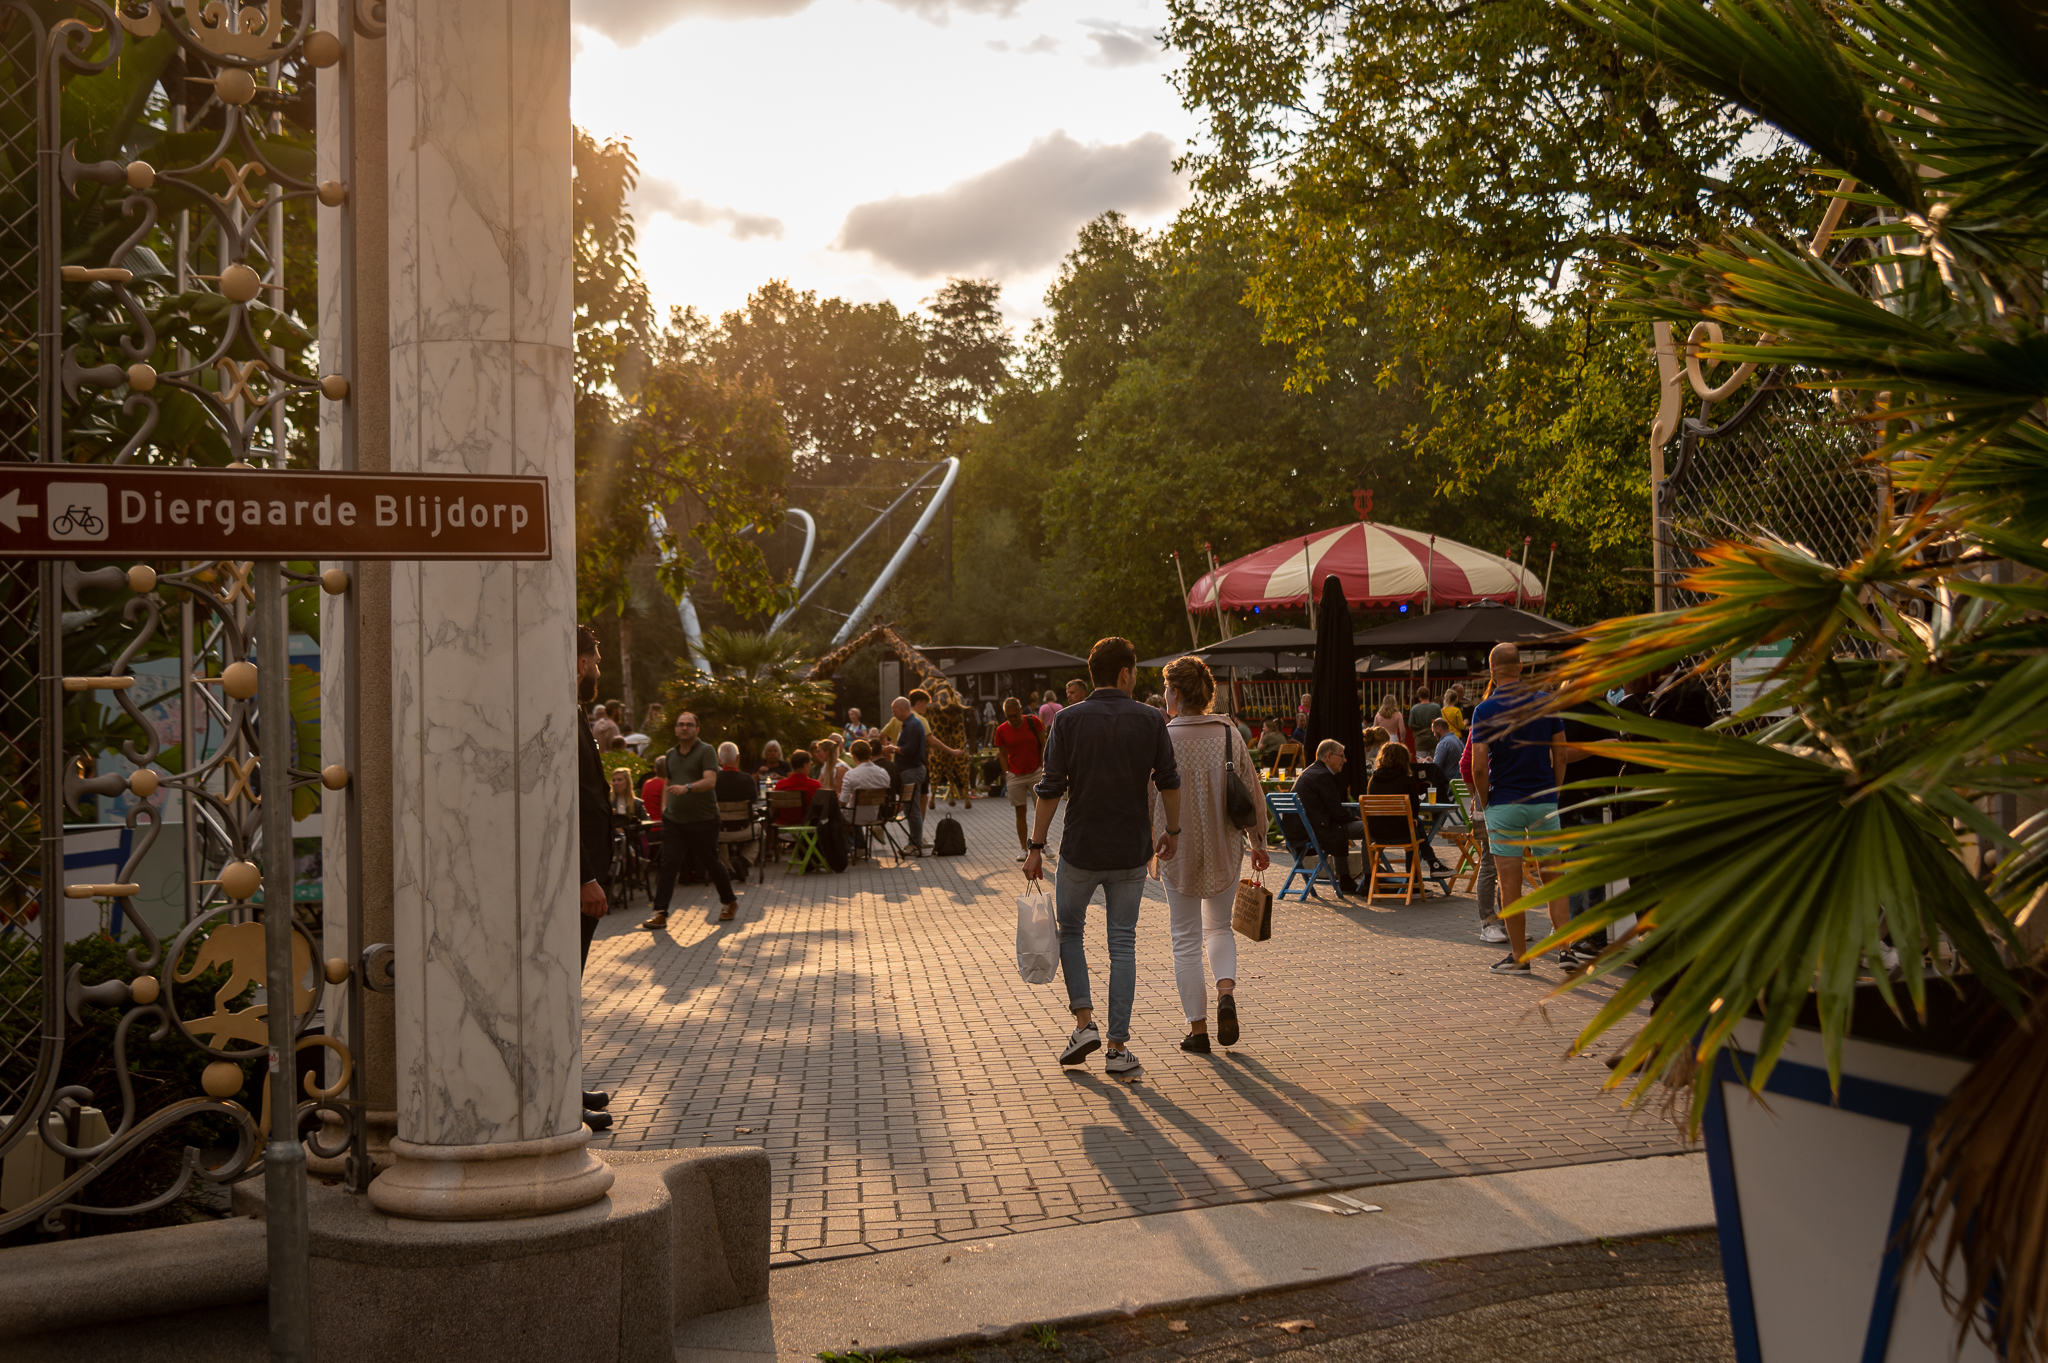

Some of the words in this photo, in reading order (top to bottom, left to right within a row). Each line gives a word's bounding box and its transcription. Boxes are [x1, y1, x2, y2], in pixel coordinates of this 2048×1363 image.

[121, 490, 356, 535] Diergaarde
[375, 494, 529, 537] Blijdorp
[1238, 892, 1259, 906] chocolate
[1243, 909, 1258, 921] nobody
